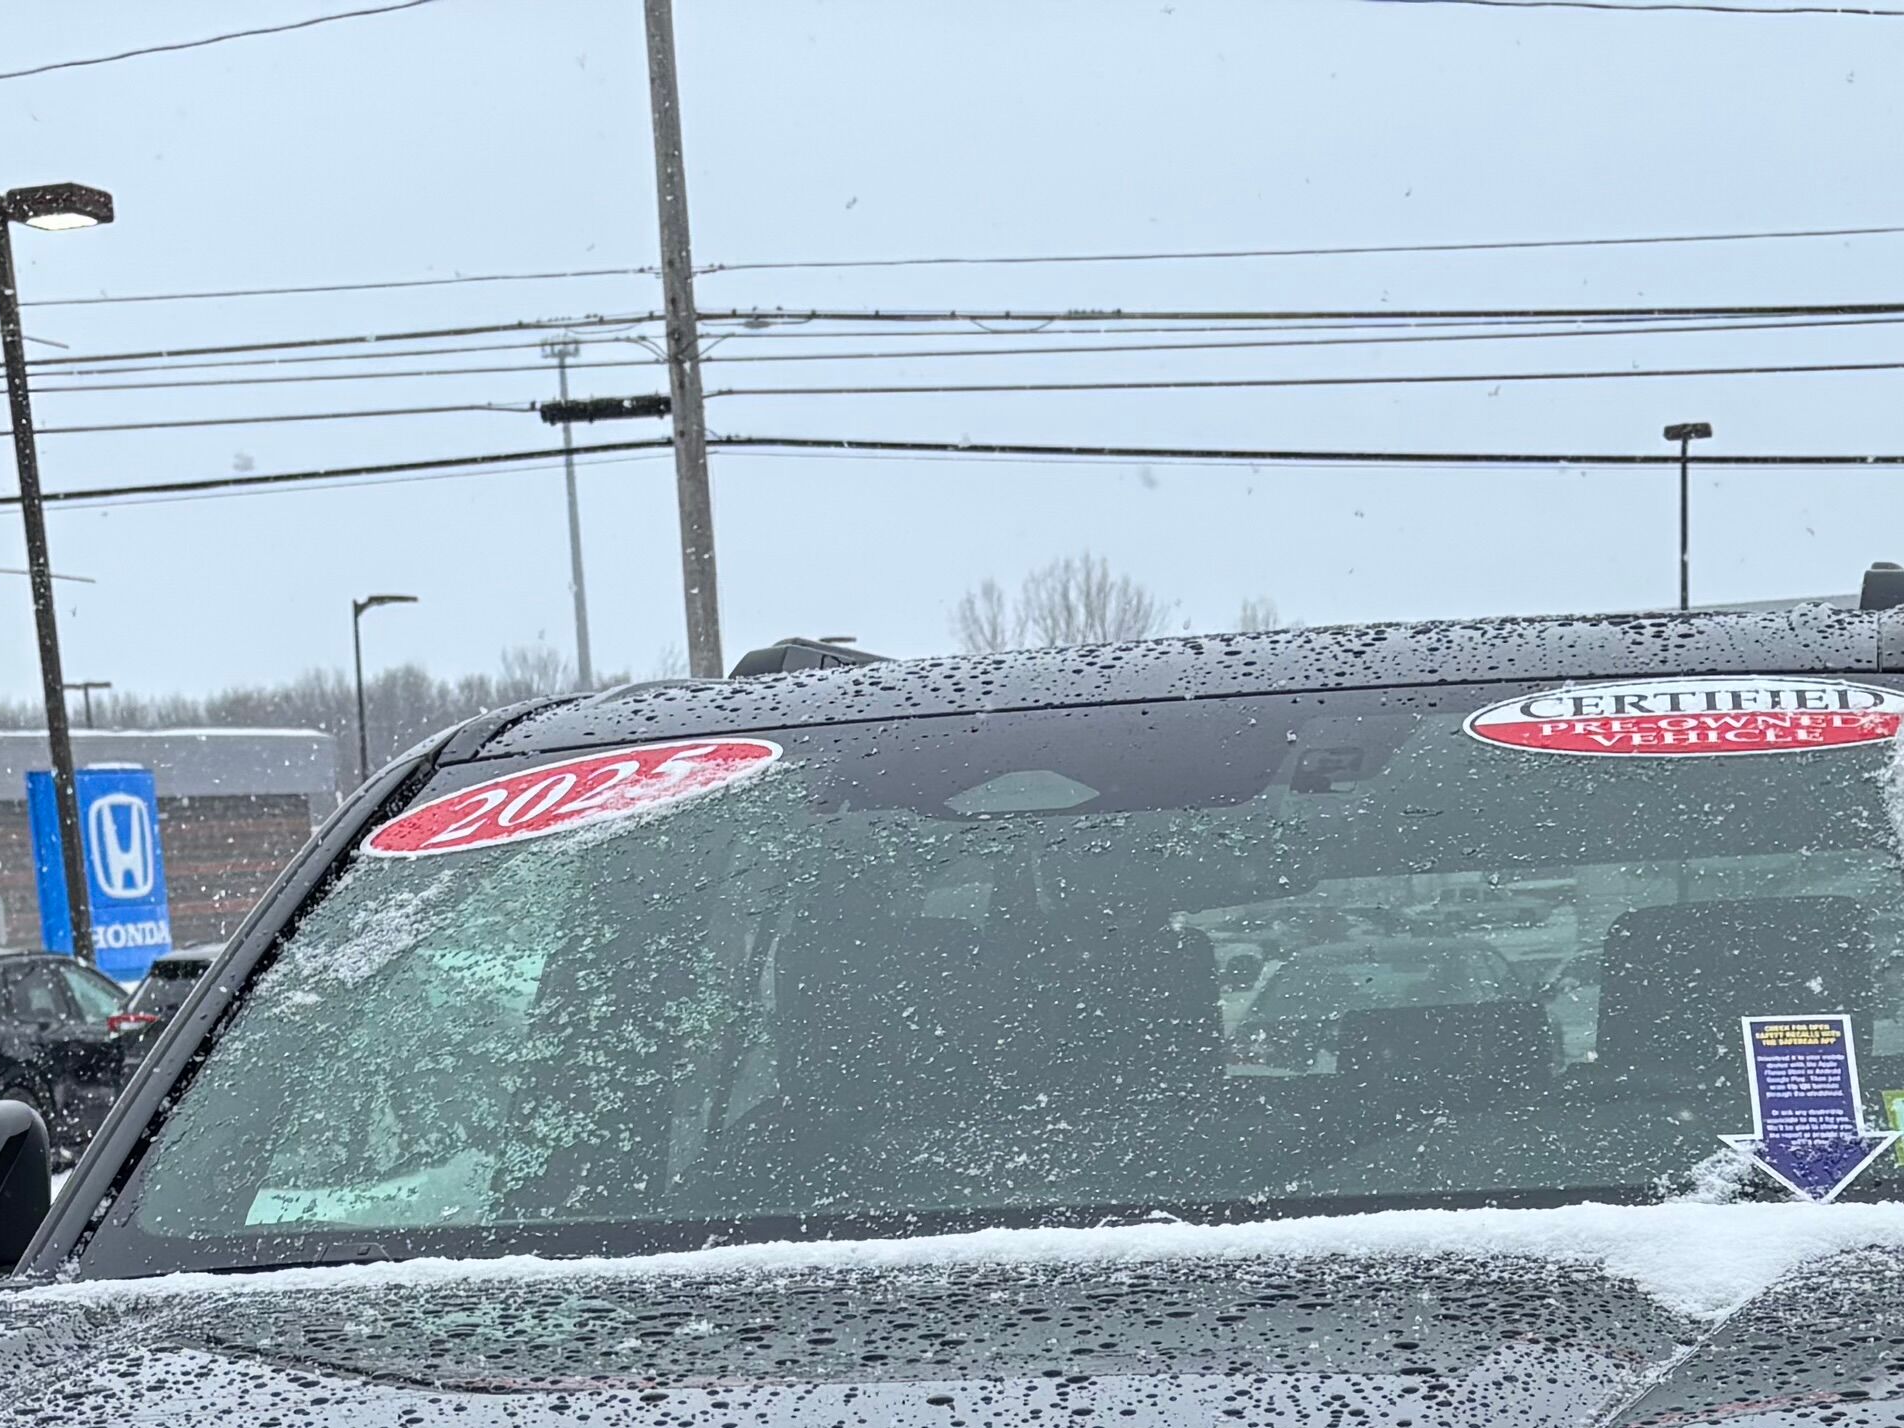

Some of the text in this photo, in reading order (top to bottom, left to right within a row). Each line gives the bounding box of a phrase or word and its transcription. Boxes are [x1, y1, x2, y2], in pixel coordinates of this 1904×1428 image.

[1520, 688, 1885, 718] CERTIFIED
[1541, 714, 1866, 736] PRE-OWNED
[1589, 728, 1825, 747] VEHICLE
[420, 745, 718, 848] 2025
